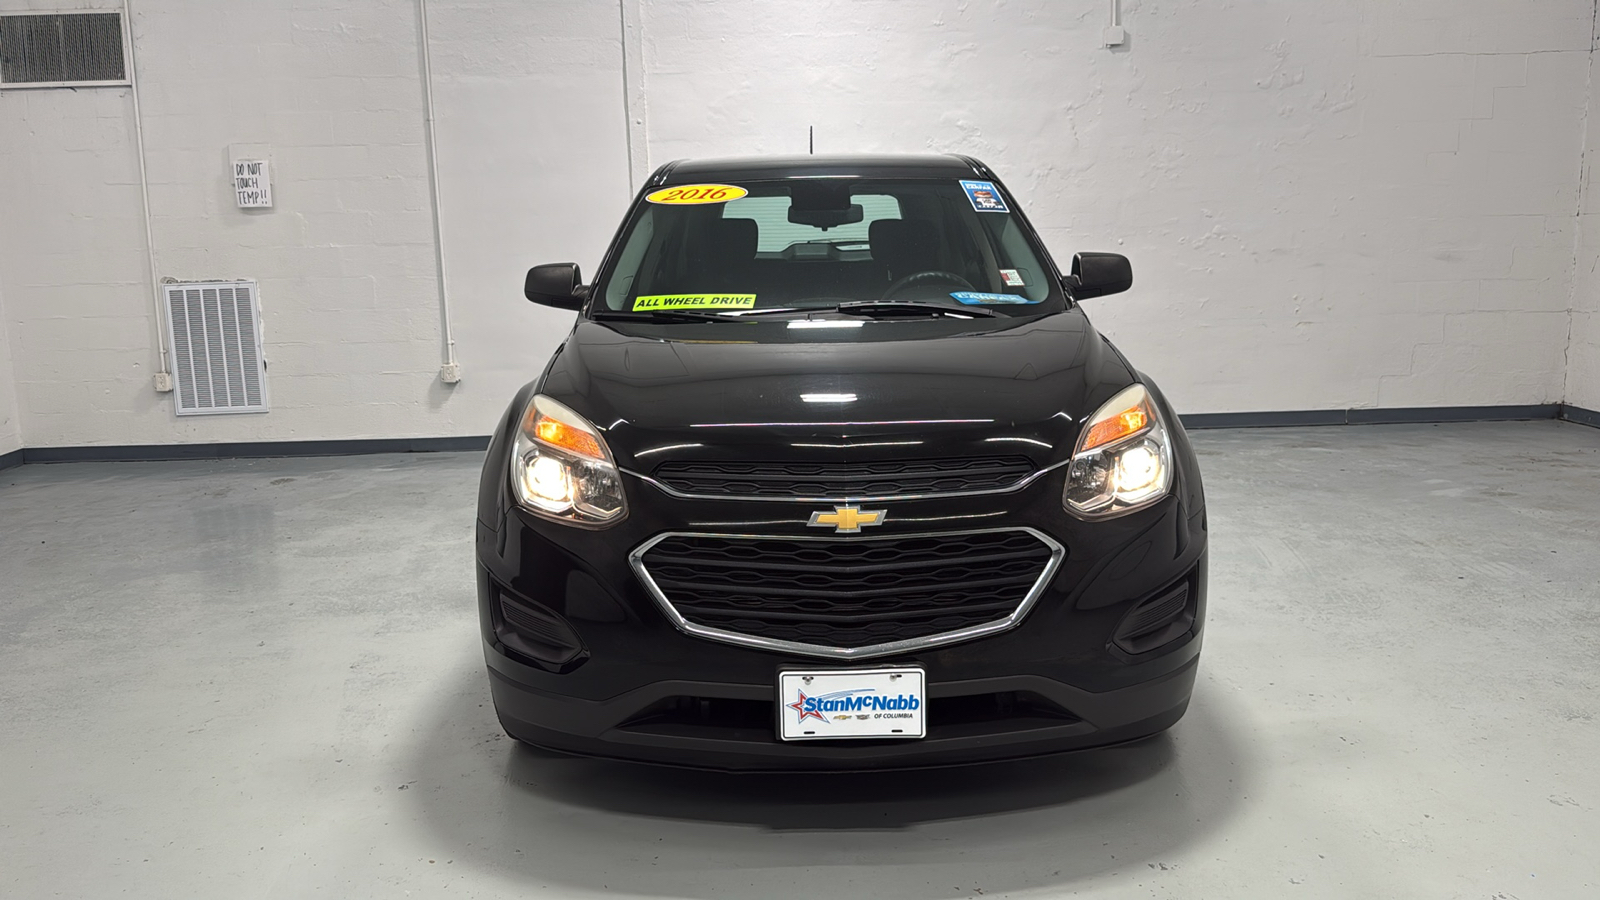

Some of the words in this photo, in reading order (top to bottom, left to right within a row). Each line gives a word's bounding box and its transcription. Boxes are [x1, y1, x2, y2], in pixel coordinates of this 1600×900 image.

[236, 163, 244, 176] DO
[247, 162, 263, 175] NOT
[236, 178, 258, 190] TOUCH
[661, 187, 733, 201] 2016
[636, 299, 660, 307] ALL
[663, 297, 706, 306] WHEEL
[709, 296, 753, 305] DRIVE
